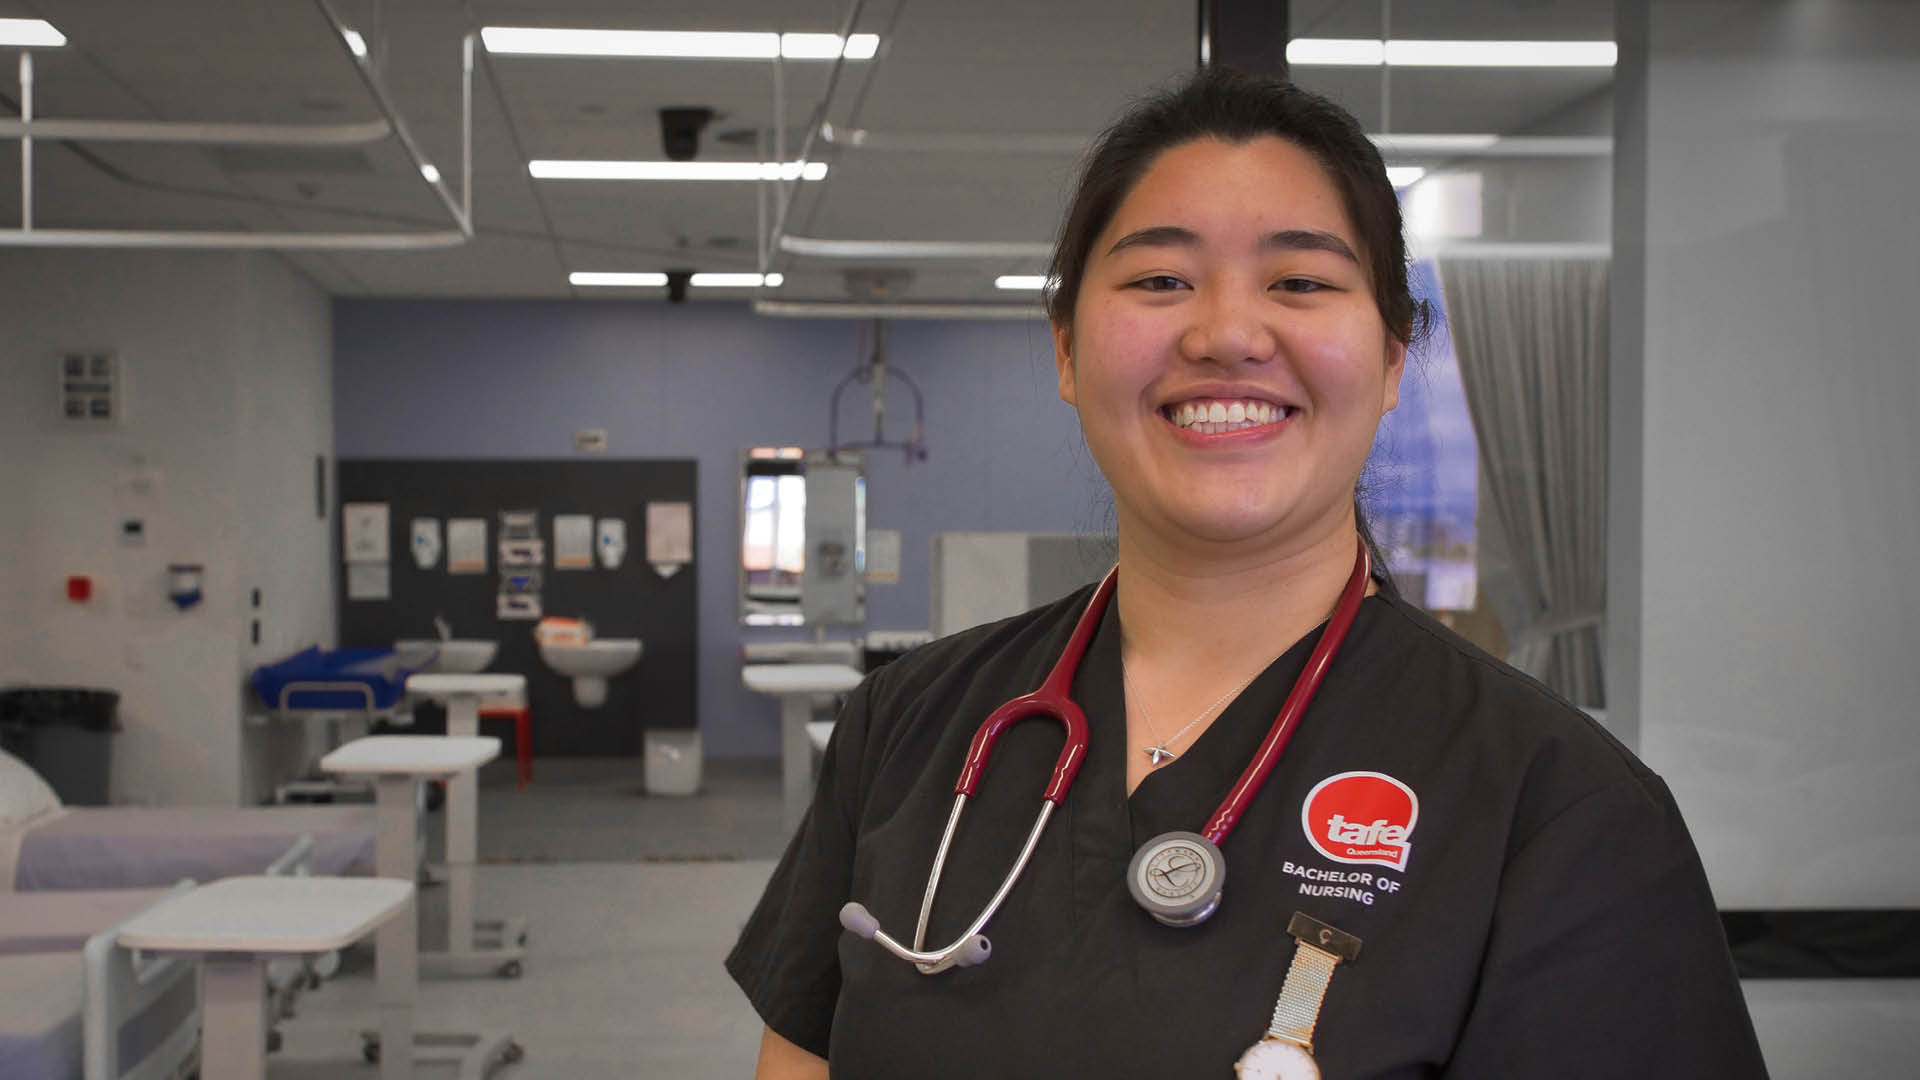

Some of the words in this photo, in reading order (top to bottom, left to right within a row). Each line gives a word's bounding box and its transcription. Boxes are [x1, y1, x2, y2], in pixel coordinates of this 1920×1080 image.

[1328, 814, 1405, 845] tafe
[1346, 848, 1398, 858] Queensland
[1282, 861, 1373, 885] BACHELOR
[1377, 877, 1401, 893] OF
[1299, 883, 1375, 905] NURSING
